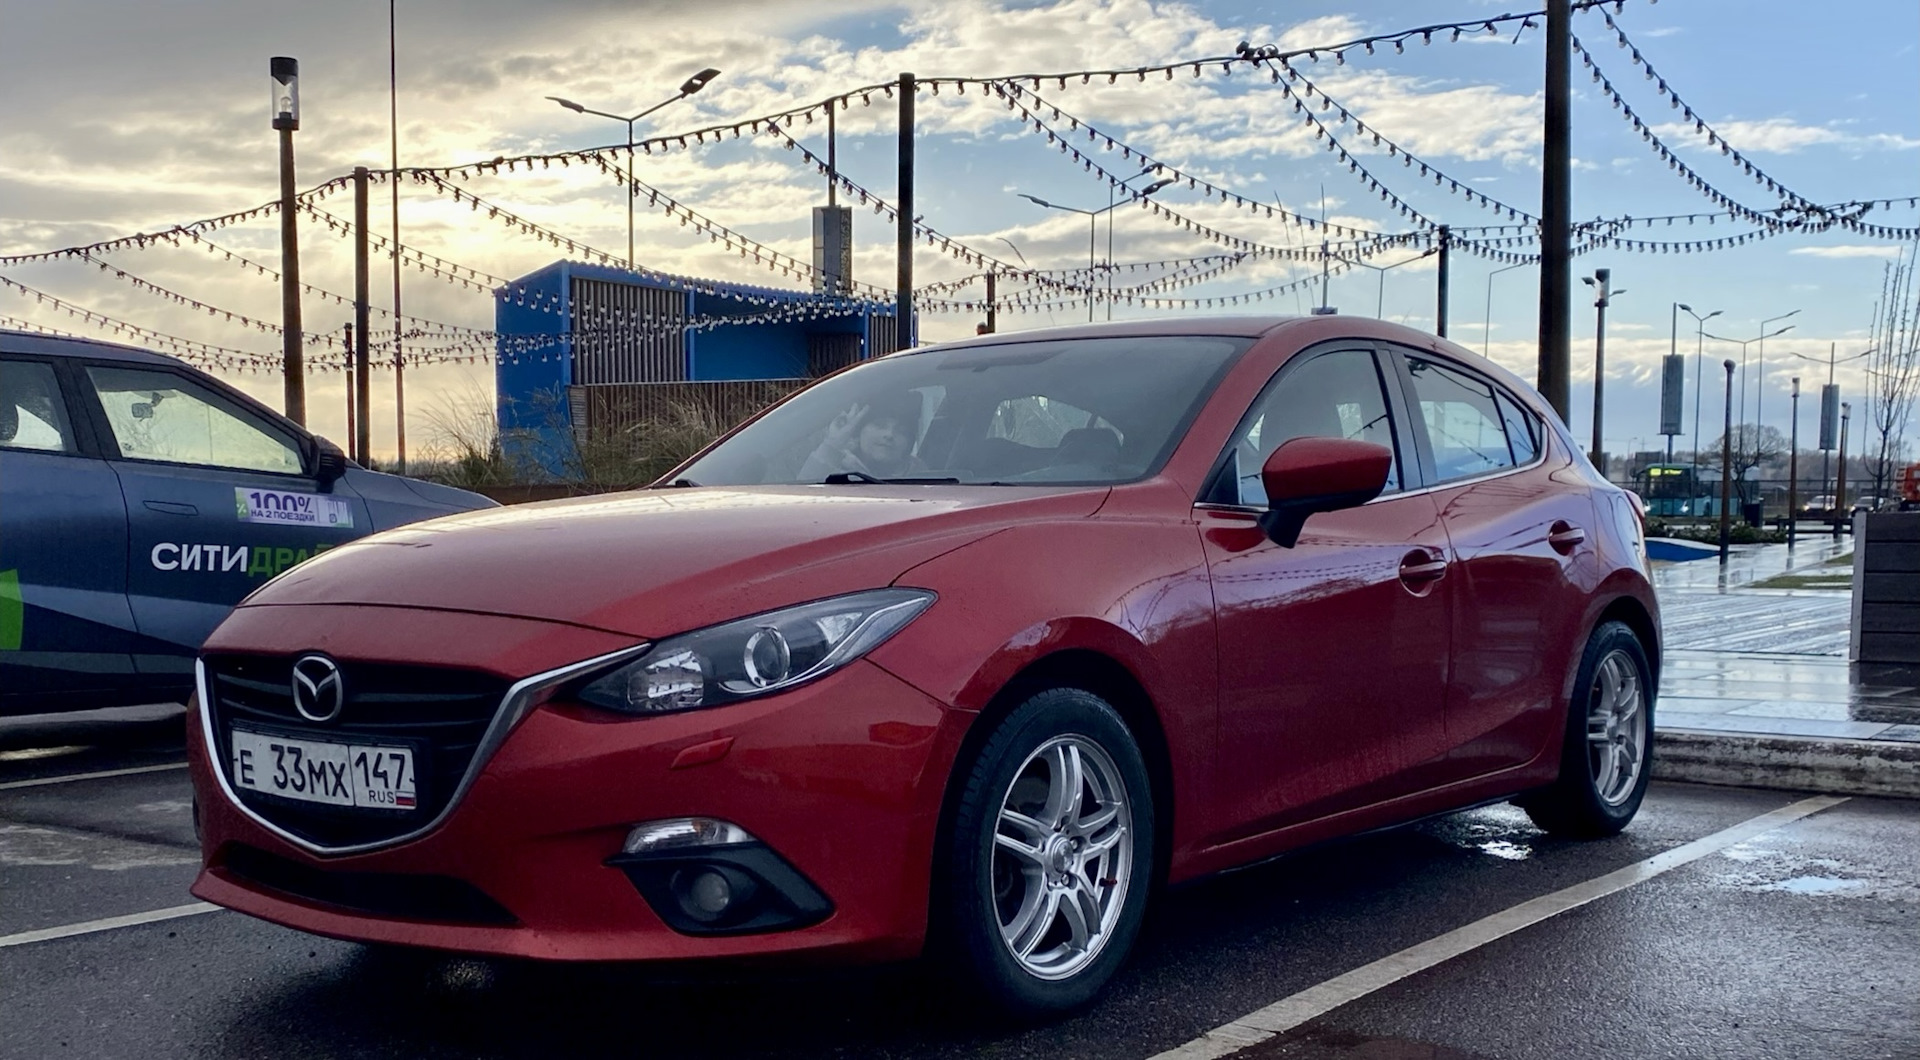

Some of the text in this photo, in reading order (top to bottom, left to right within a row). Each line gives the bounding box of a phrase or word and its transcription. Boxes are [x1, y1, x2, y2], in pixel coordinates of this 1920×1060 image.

[250, 492, 314, 513] 100%
[250, 508, 316, 522] НА 2 ПОЕЗДКИ
[151, 542, 335, 577] СИТИДРА
[355, 751, 405, 790] 147
[368, 789, 395, 804] RUS
